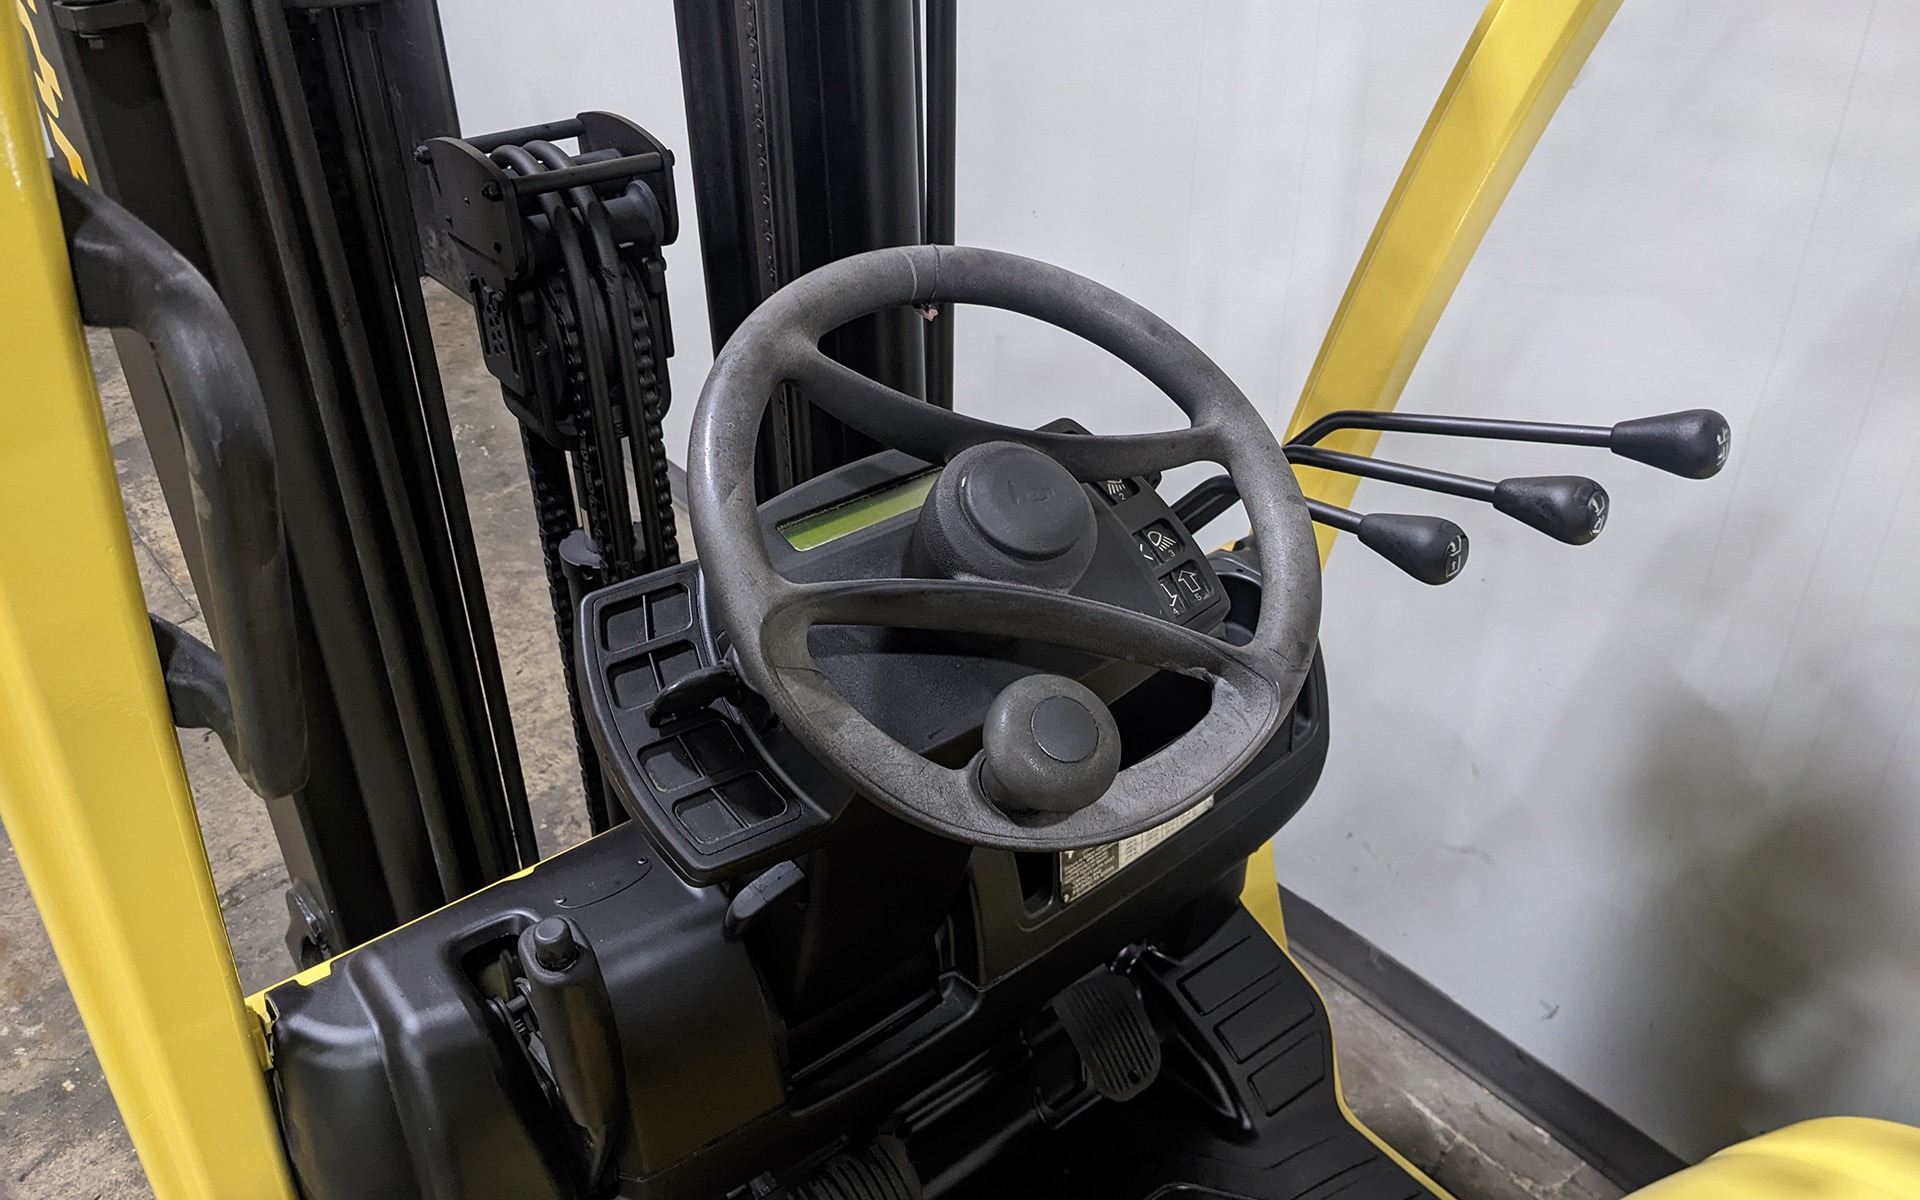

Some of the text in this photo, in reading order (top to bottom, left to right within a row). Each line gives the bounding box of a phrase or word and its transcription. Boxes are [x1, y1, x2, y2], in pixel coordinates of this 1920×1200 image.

[1168, 549, 1176, 558] 3
[1194, 592, 1203, 602] 5
[1172, 607, 1180, 616] 4
